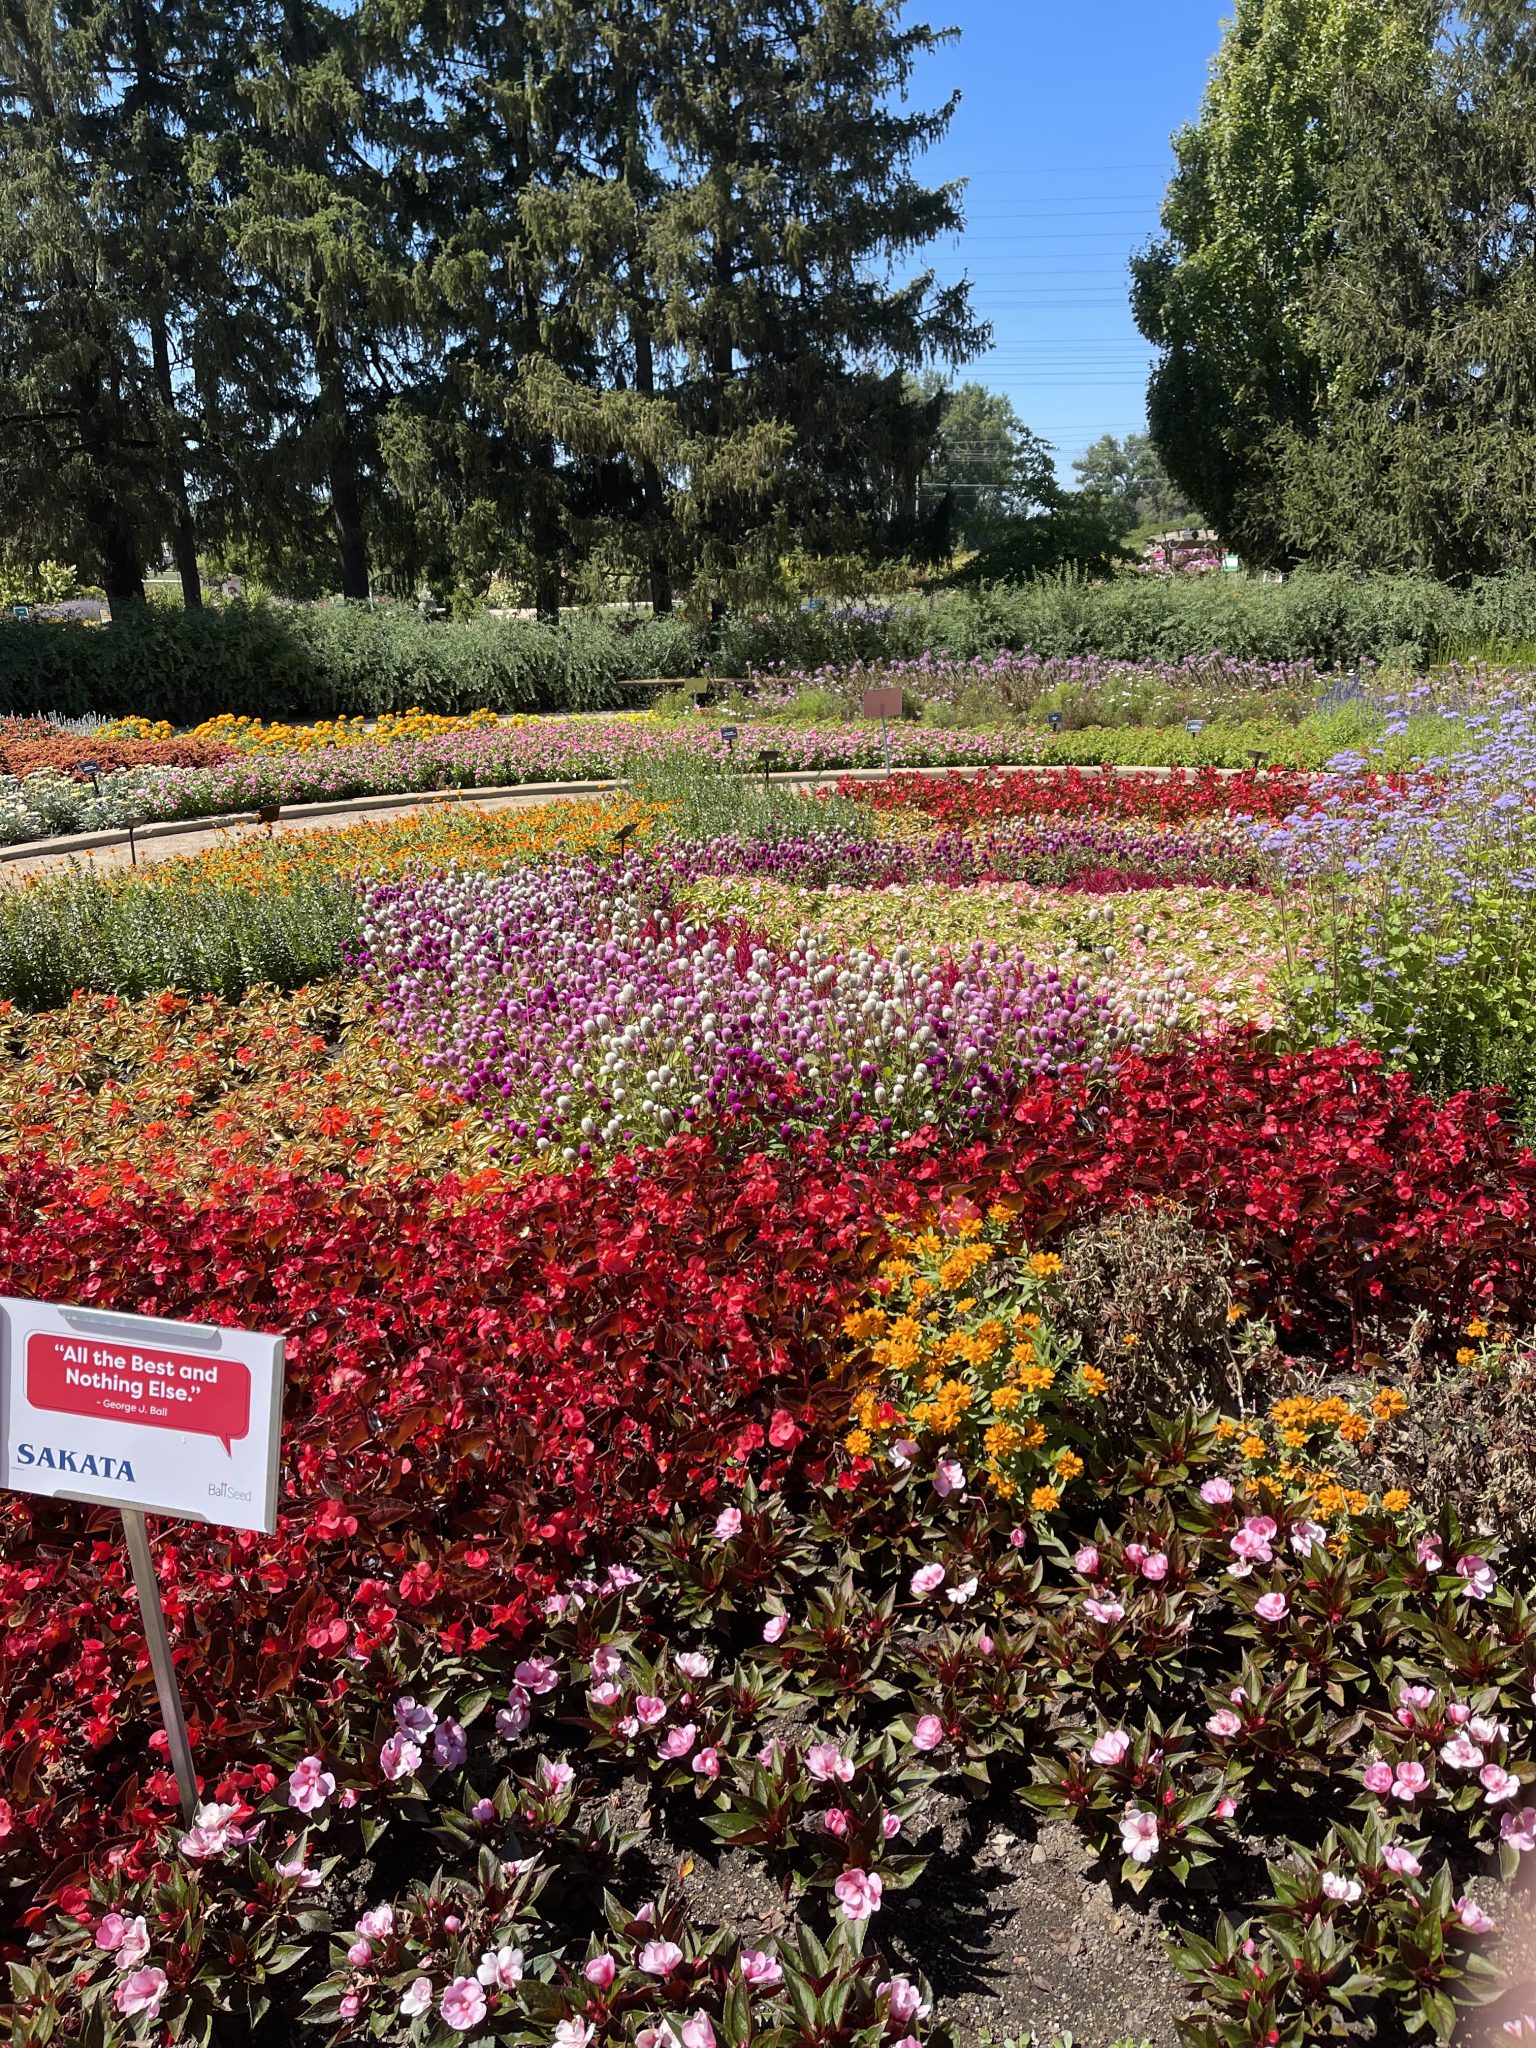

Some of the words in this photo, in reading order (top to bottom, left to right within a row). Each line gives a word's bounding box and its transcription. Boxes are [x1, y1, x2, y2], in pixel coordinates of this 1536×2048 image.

[54, 1344, 88, 1364] “All
[93, 1350, 126, 1370] the
[131, 1355, 175, 1377] Best
[179, 1366, 218, 1383] and
[65, 1368, 143, 1399] Nothing
[148, 1380, 201, 1402] Else.”
[102, 1399, 137, 1414] George
[138, 1405, 148, 1414] J.
[150, 1407, 168, 1417] Ball
[16, 1443, 136, 1483] SAKATA
